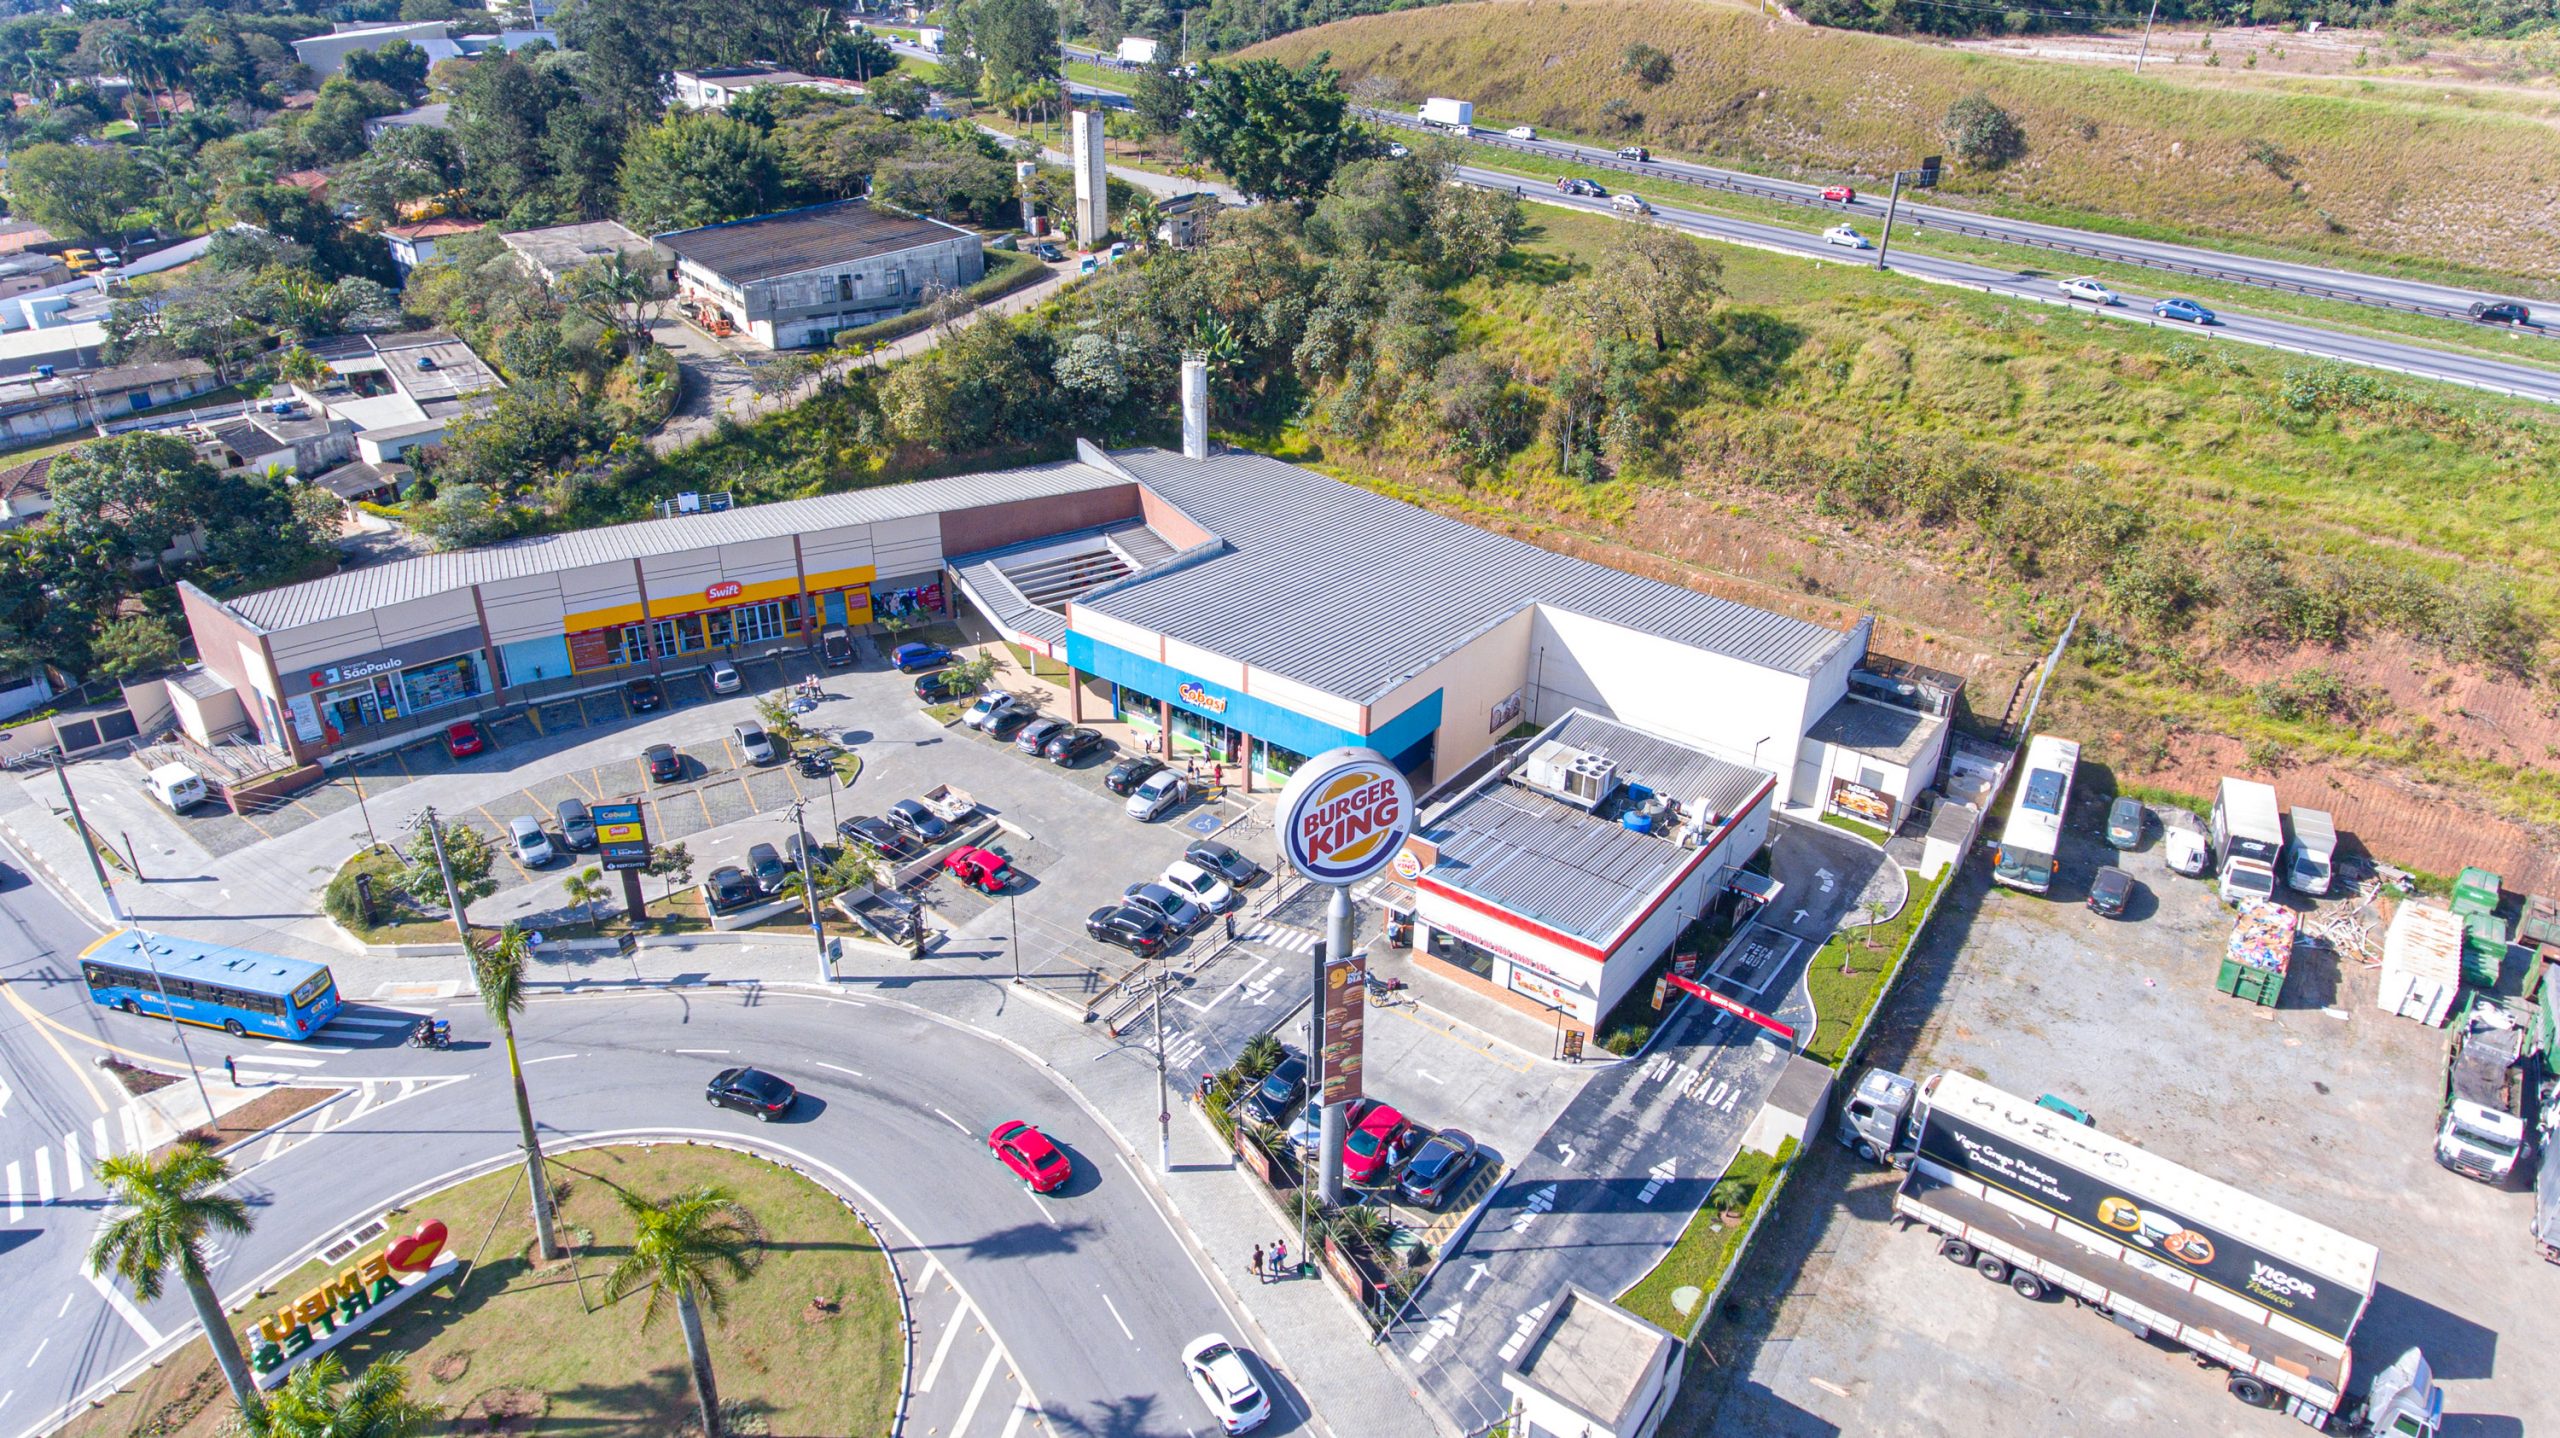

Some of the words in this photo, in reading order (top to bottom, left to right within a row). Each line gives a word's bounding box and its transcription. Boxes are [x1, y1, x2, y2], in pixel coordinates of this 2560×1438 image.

[709, 584, 739, 600] Swift
[1179, 683, 1227, 714] Cobasi
[1303, 778, 1395, 838] BURGER
[1307, 797, 1399, 866] KING
[1954, 1131, 1982, 1150] Vigor
[1983, 1145, 2014, 1166] Grego
[1970, 1151, 2017, 1178] Descubra
[2018, 1175, 2041, 1189] esse
[2042, 1185, 2071, 1202] sabor
[2246, 1281, 2295, 1308] Pedaços
[2254, 1260, 2317, 1300] VIGOR
